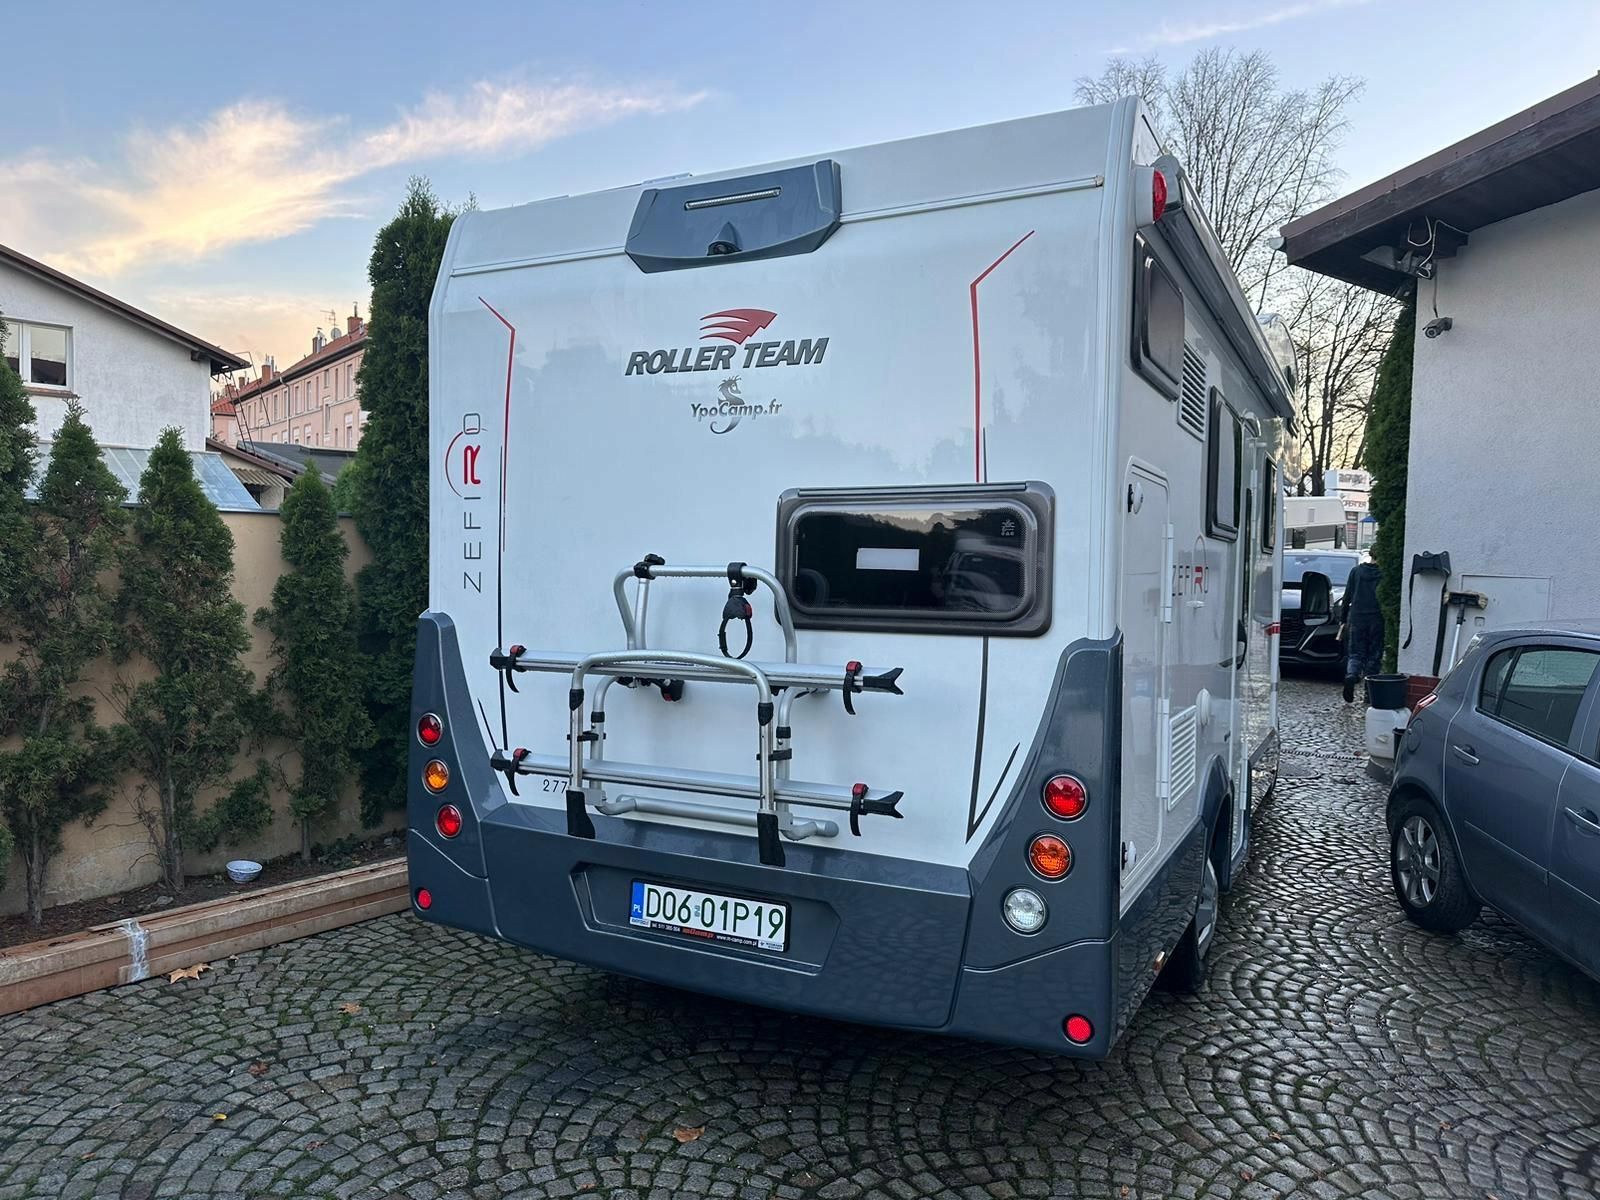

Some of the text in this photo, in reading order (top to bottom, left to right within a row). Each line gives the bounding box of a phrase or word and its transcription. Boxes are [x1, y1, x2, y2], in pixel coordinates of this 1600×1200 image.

[624, 337, 830, 376] ROLLER TEAM
[690, 399, 783, 421] YpoCamp.fr
[463, 412, 482, 593] ZEFIRO
[543, 778, 568, 794] 277
[633, 904, 642, 914] PL
